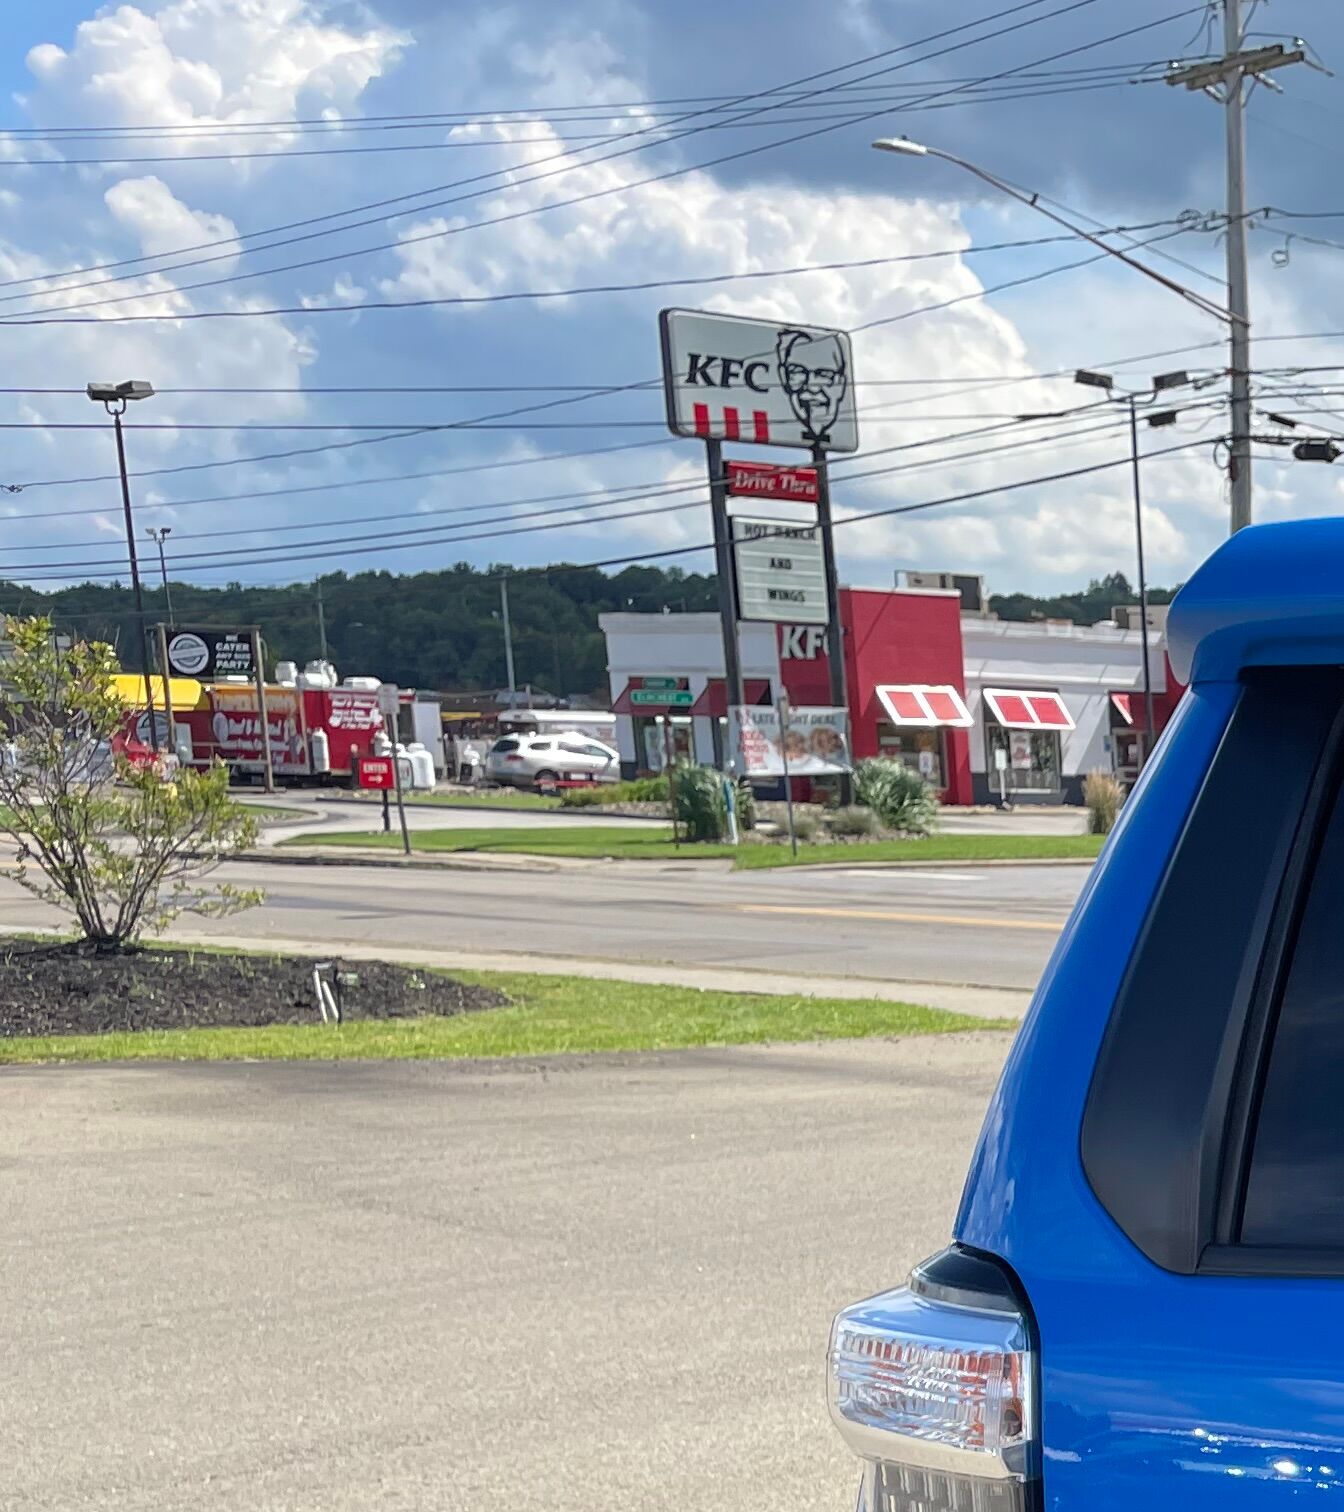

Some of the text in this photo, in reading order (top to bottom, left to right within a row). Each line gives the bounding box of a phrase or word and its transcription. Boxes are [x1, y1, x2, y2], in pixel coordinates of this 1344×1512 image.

[685, 353, 769, 393] KFC
[734, 470, 816, 495] Drive Thru
[769, 558, 792, 570] AND
[768, 588, 805, 602] WINGS
[215, 642, 250, 652] CATER
[216, 660, 250, 669] PARTY
